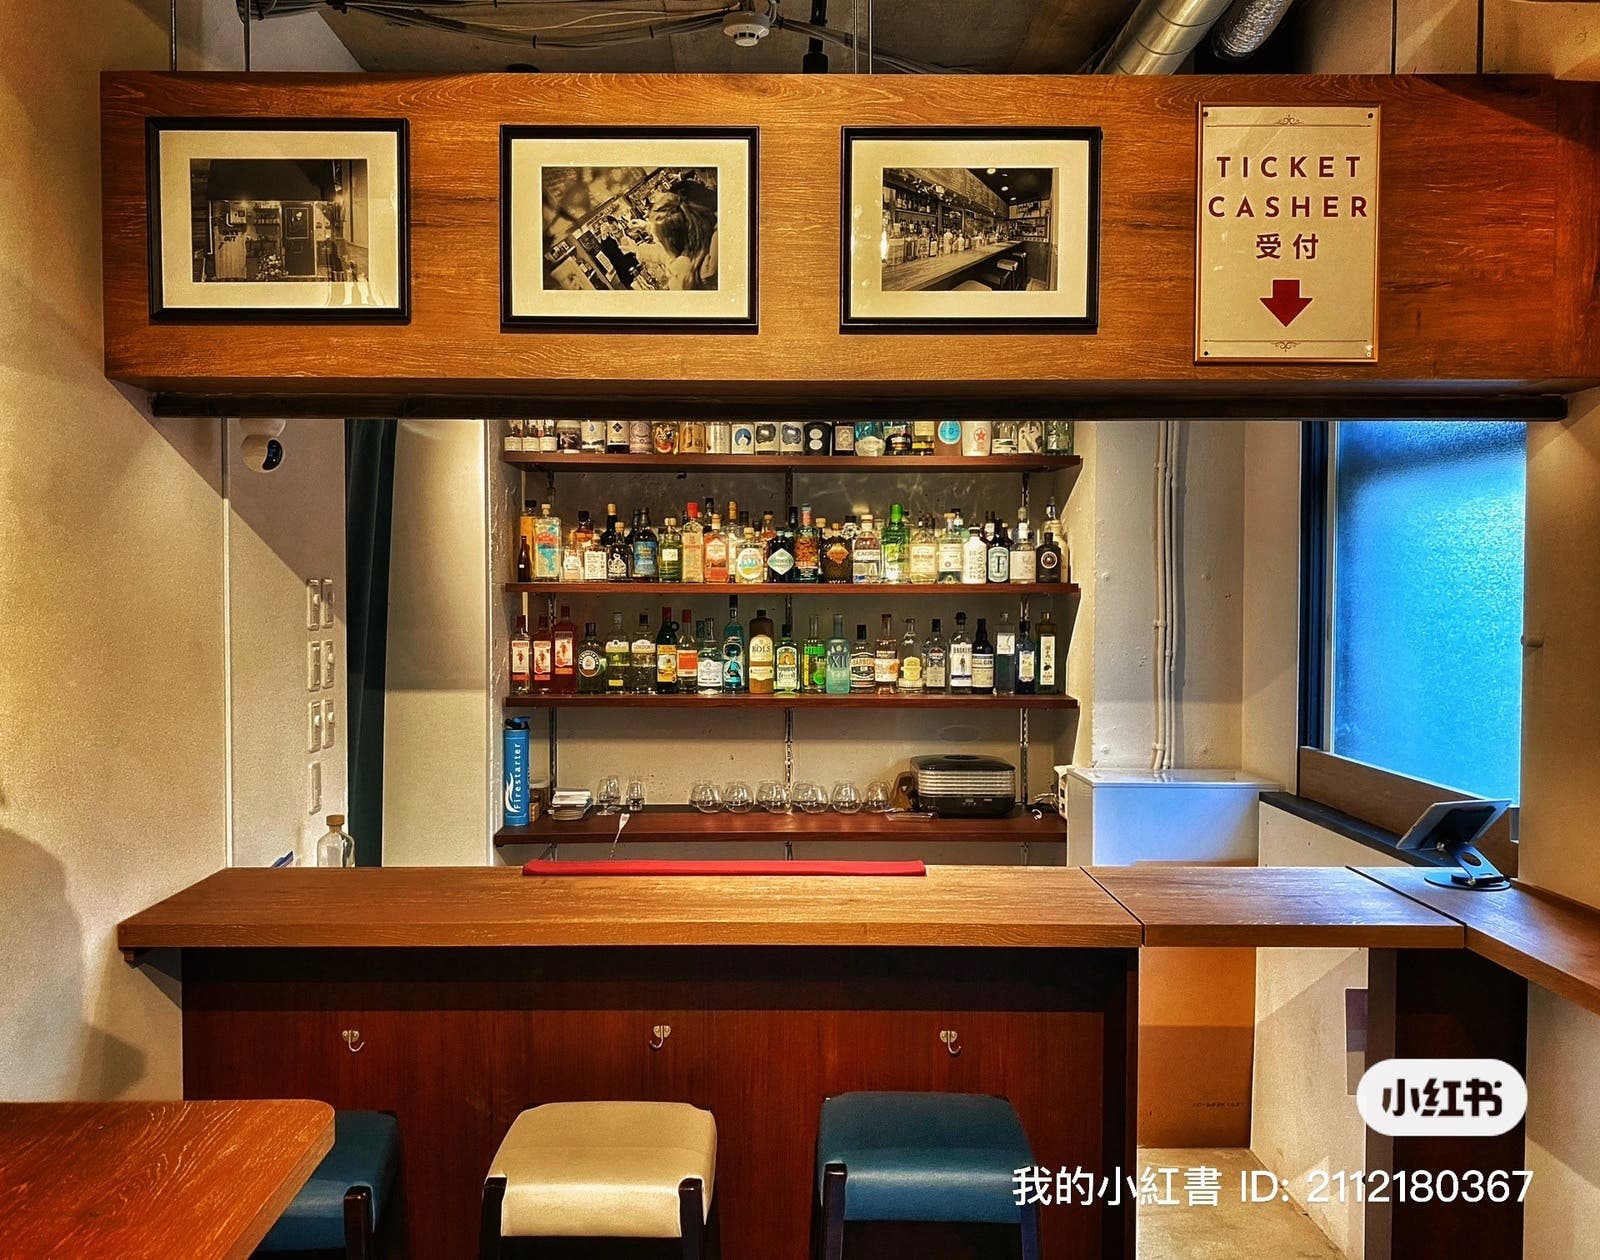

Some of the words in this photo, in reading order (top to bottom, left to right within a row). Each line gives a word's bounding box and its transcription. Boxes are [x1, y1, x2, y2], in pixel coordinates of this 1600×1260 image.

[1216, 156, 1361, 178] TICKET
[1208, 196, 1368, 218] CASHER
[1256, 233, 1319, 260] 受付
